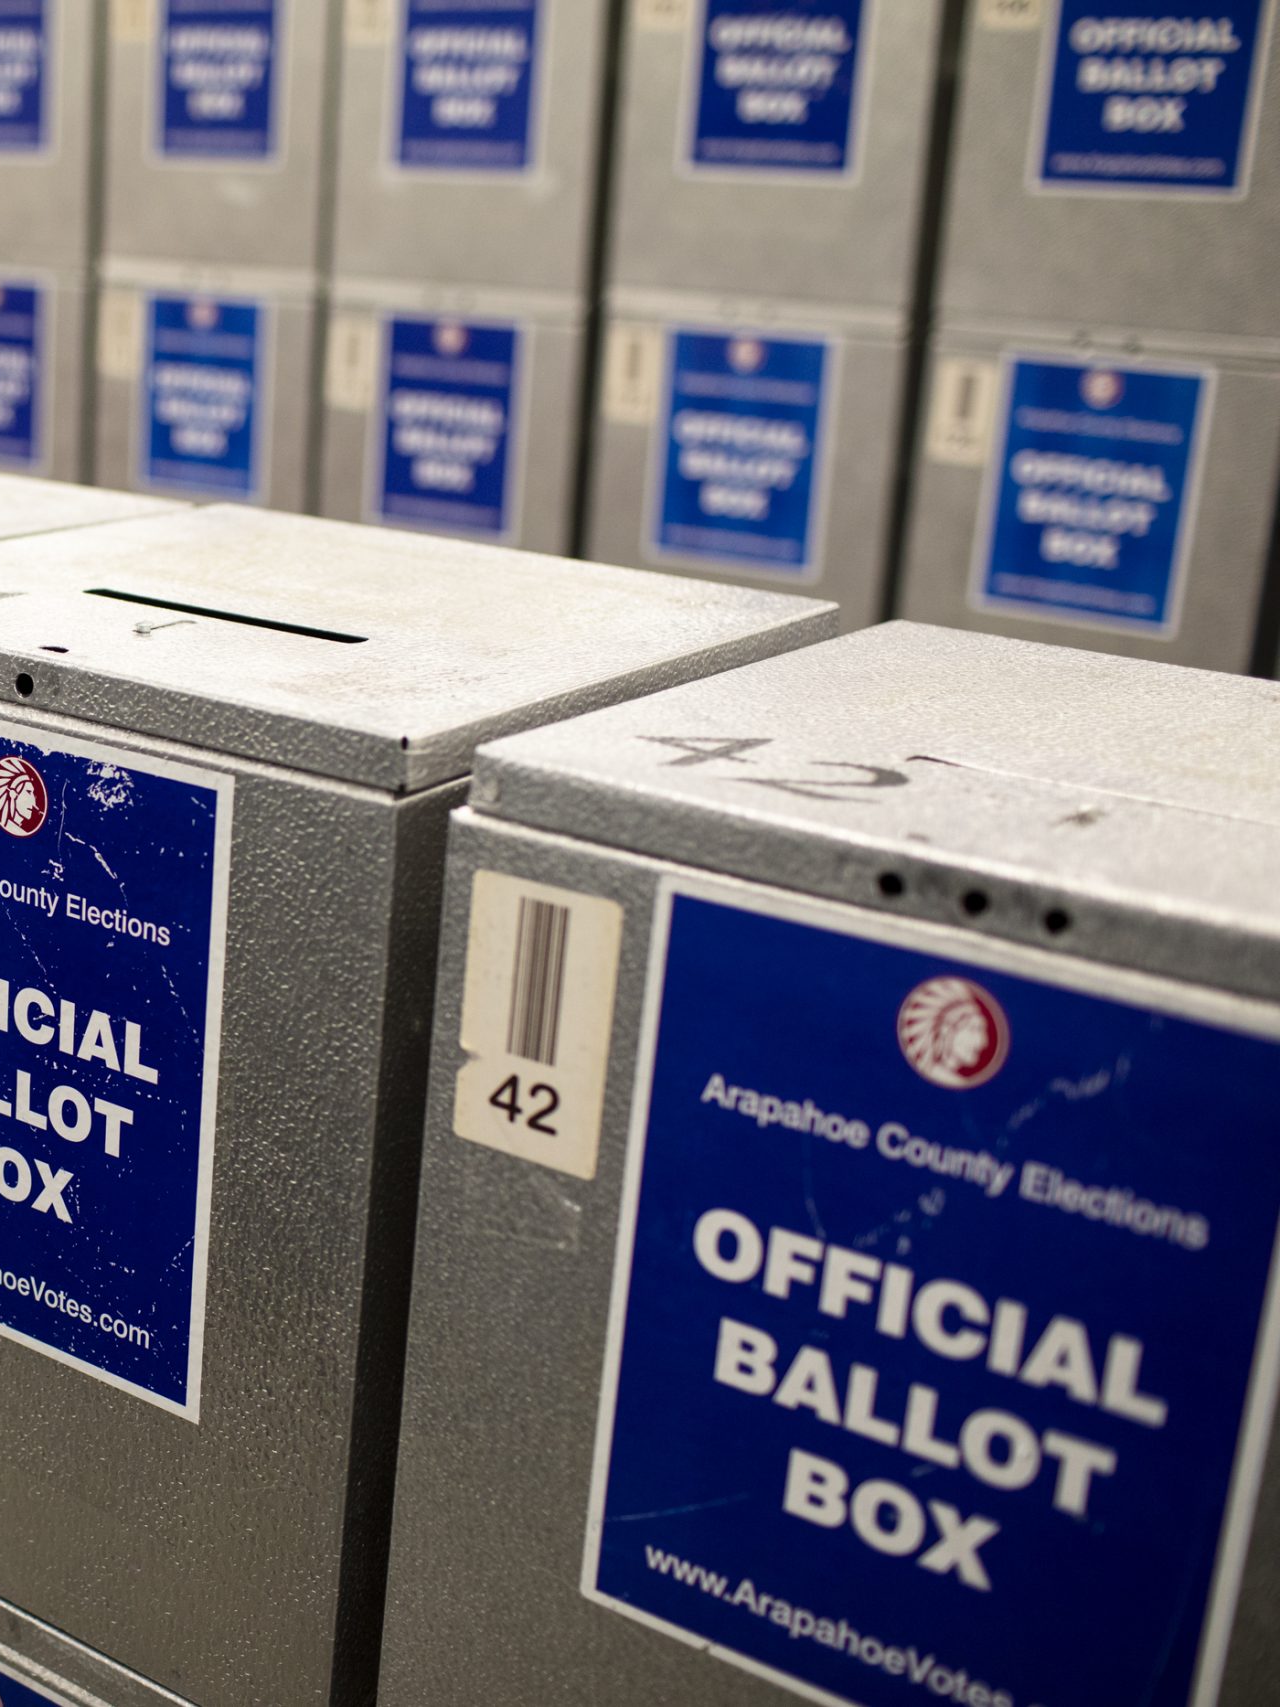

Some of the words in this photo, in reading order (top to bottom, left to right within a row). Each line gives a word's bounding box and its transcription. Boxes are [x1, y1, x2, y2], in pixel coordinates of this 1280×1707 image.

[1070, 16, 1241, 53] OFFICIAL
[1076, 56, 1226, 94] BALLOT
[1101, 95, 1187, 133] BOX
[635, 735, 910, 803] 42
[66, 893, 170, 946] Elections
[488, 1073, 560, 1136] 42
[702, 1073, 870, 1151] Arapahoe
[877, 1122, 1013, 1197] County
[1020, 1161, 1210, 1250] Elections
[692, 1208, 1167, 1427] OFFICIAL
[714, 1316, 1117, 1518] BALLOT
[783, 1447, 1001, 1592] BOX
[645, 1545, 1042, 1707] www.ArapahoeVotes
